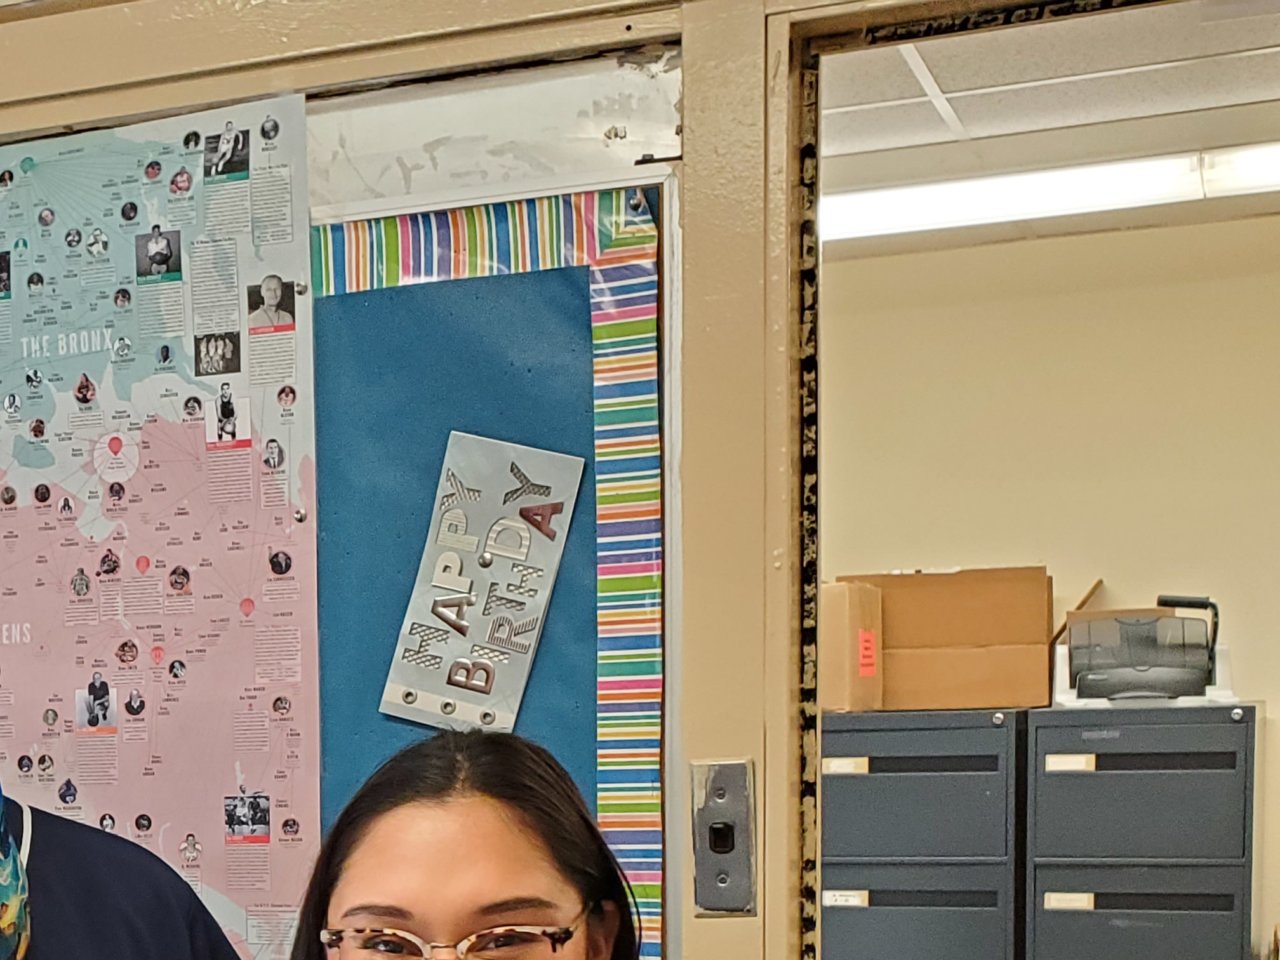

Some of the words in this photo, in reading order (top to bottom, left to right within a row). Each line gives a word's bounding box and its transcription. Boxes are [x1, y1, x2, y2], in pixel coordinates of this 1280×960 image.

[20, 335, 50, 358] THE
[58, 327, 112, 355] BRONX
[402, 467, 481, 670] HAPPY
[446, 461, 565, 695] BIRTHDAY
